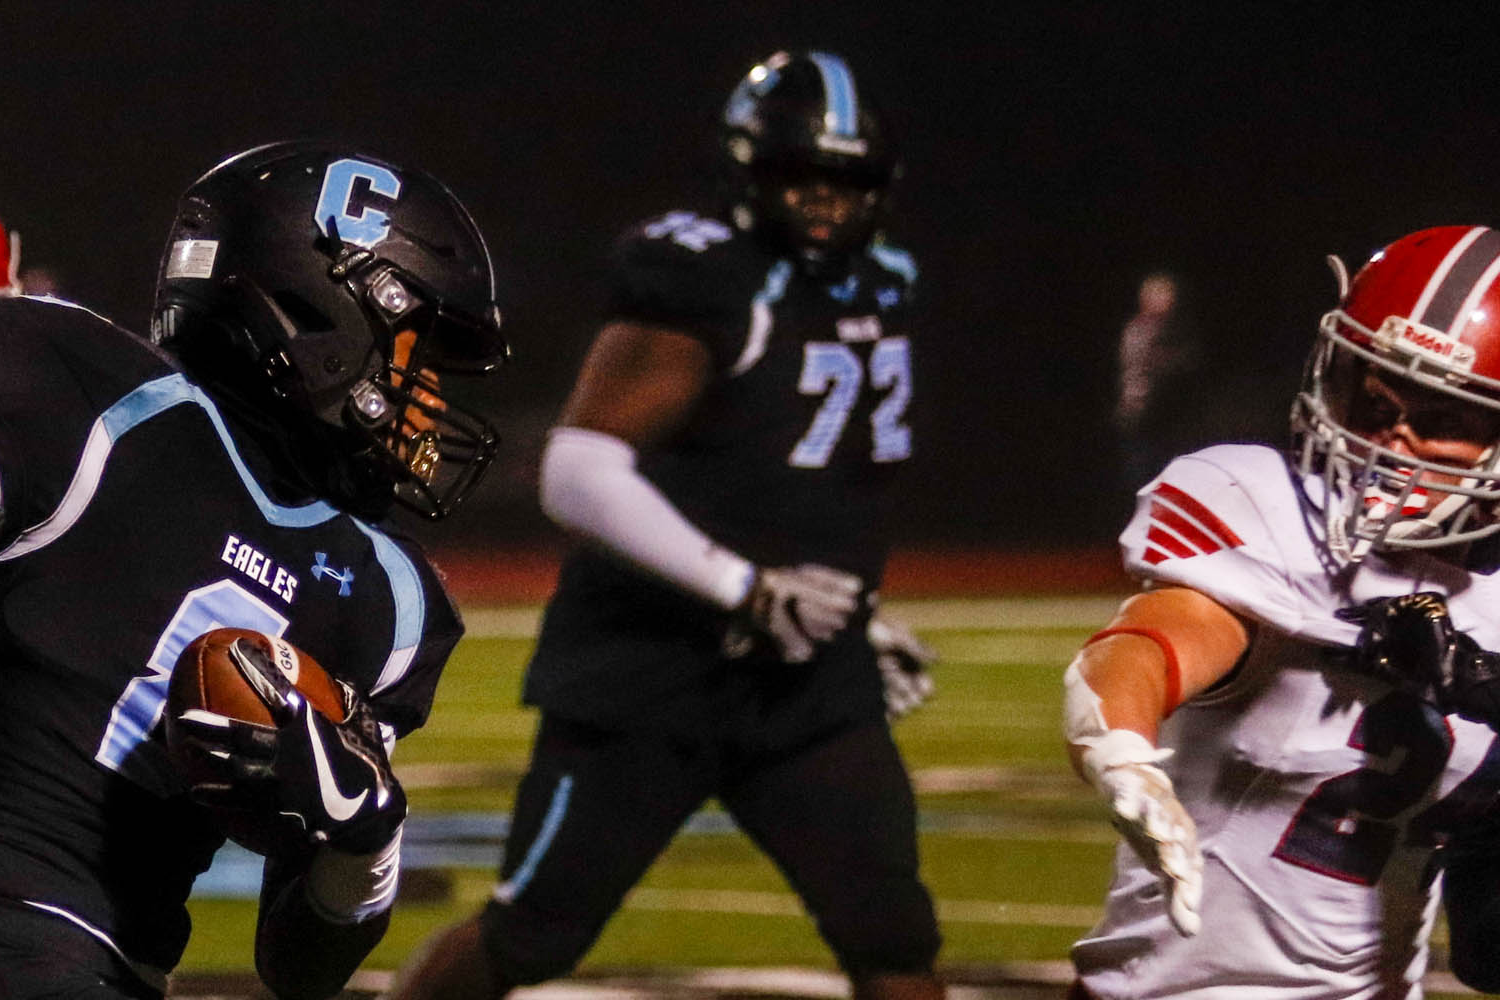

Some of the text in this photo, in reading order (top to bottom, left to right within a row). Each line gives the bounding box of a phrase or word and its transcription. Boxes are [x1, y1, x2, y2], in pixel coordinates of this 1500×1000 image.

[313, 157, 402, 250] C
[1404, 325, 1455, 356] Riddell
[788, 336, 912, 468] 72
[220, 534, 299, 604] EAGLES
